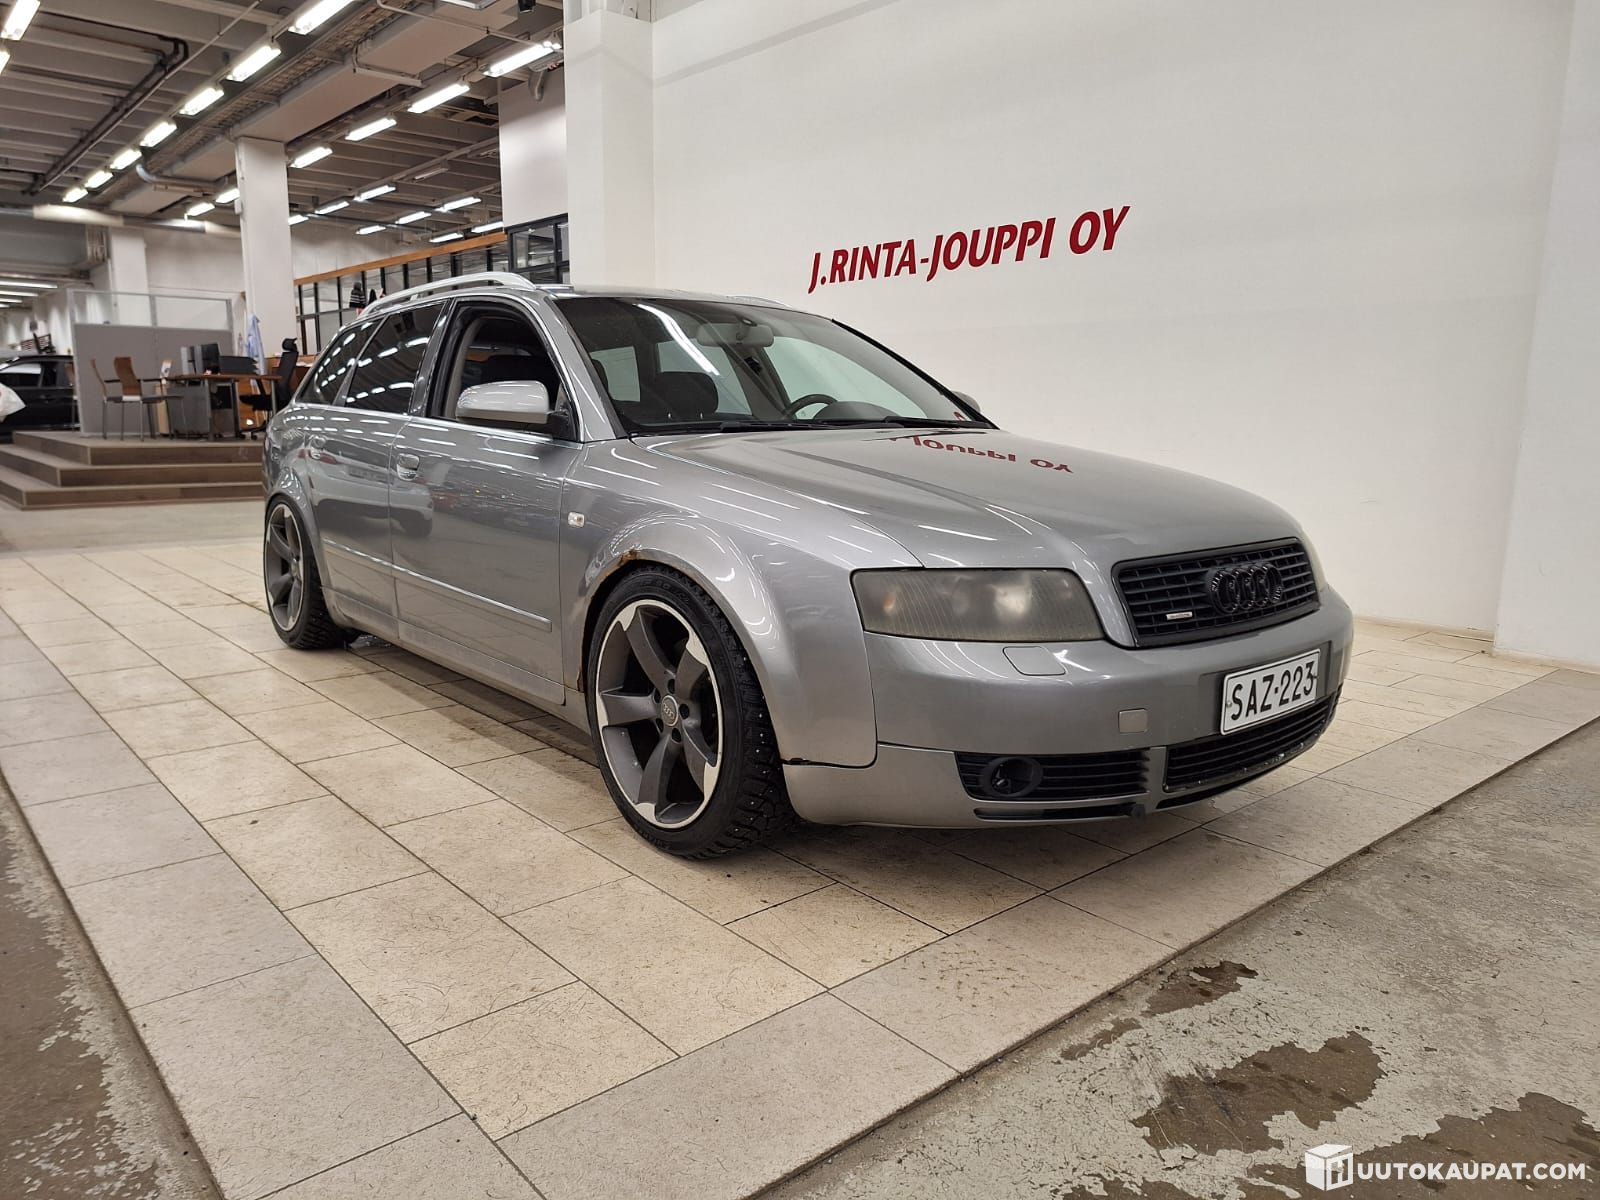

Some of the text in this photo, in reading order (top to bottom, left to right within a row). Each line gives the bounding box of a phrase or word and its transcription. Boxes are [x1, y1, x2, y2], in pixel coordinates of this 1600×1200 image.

[808, 206, 1131, 294] J.RINTA-JOUPPI OY
[1230, 660, 1317, 721] SAZ-223
